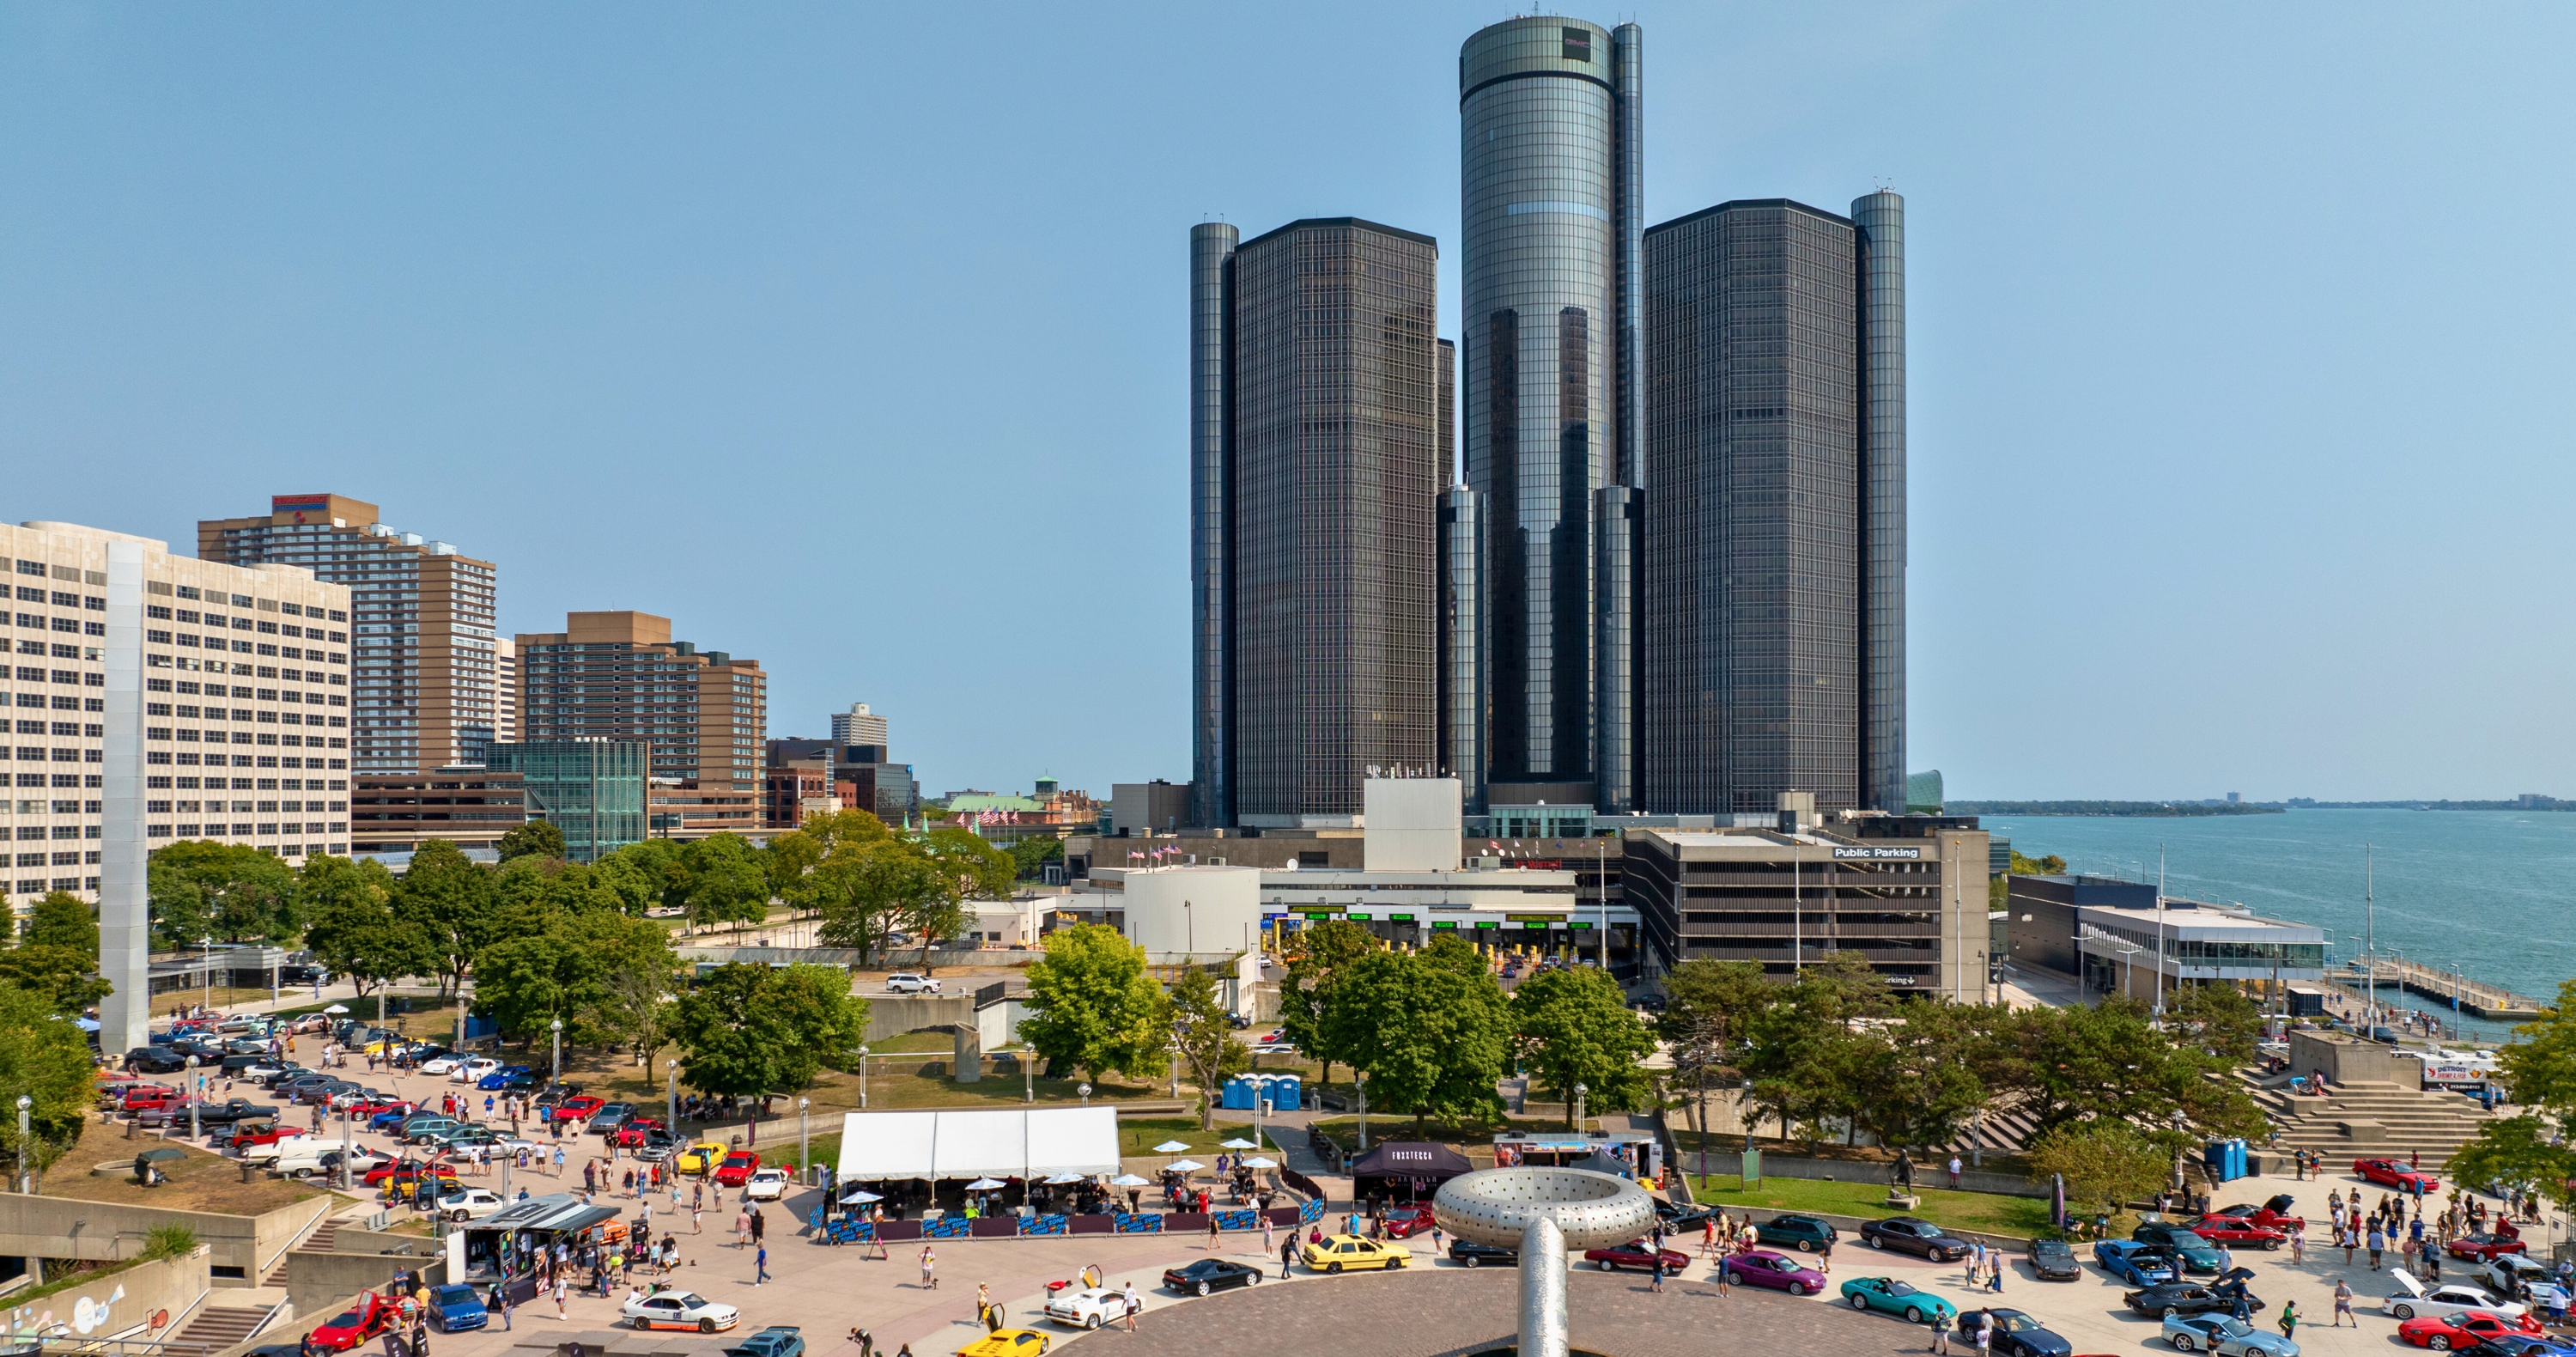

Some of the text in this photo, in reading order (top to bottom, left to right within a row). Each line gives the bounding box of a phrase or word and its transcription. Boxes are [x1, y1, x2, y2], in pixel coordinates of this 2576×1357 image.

[1835, 849, 1917, 858] Public Parking
[1884, 976, 1907, 984] arking
[1392, 1151, 1432, 1159] FOXXTECCA
[1239, 1212, 1255, 1220] ZONE
[856, 1223, 872, 1232] ZONE
[933, 1226, 951, 1234] CHILL
[952, 1220, 969, 1228] ZONE
[1030, 1217, 1065, 1232] CHILL ZONE
[1127, 1220, 1143, 1229] CHILL
